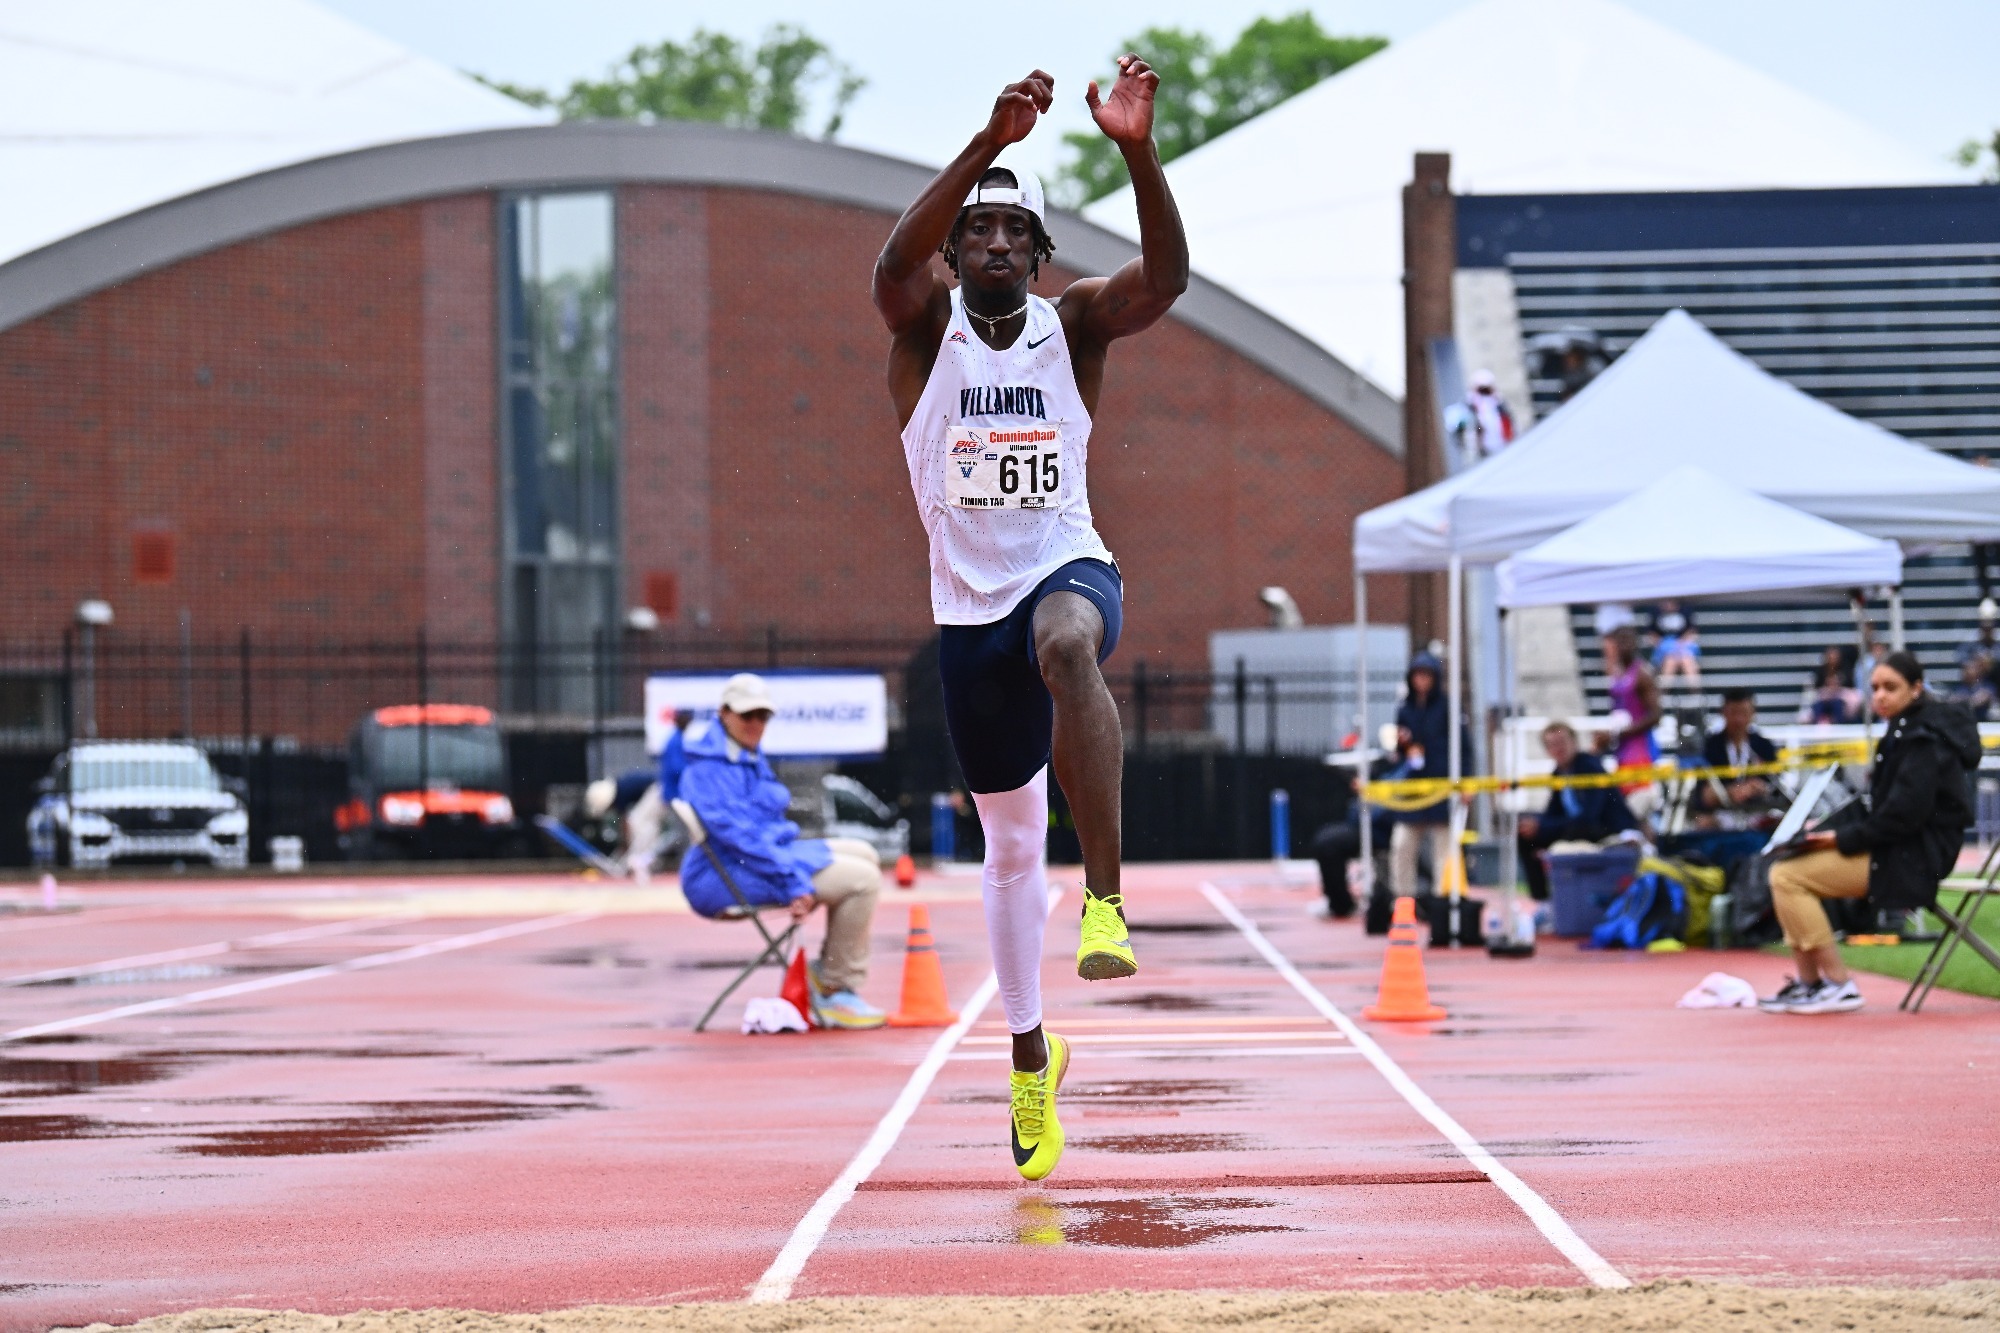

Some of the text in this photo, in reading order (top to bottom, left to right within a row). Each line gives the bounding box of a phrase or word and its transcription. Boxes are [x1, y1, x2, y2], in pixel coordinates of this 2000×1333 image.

[961, 386, 1047, 421] VILLANOVA
[990, 430, 1056, 443] Cunningham
[1000, 453, 1059, 494] 615
[960, 497, 1005, 506] TIMING TAG
